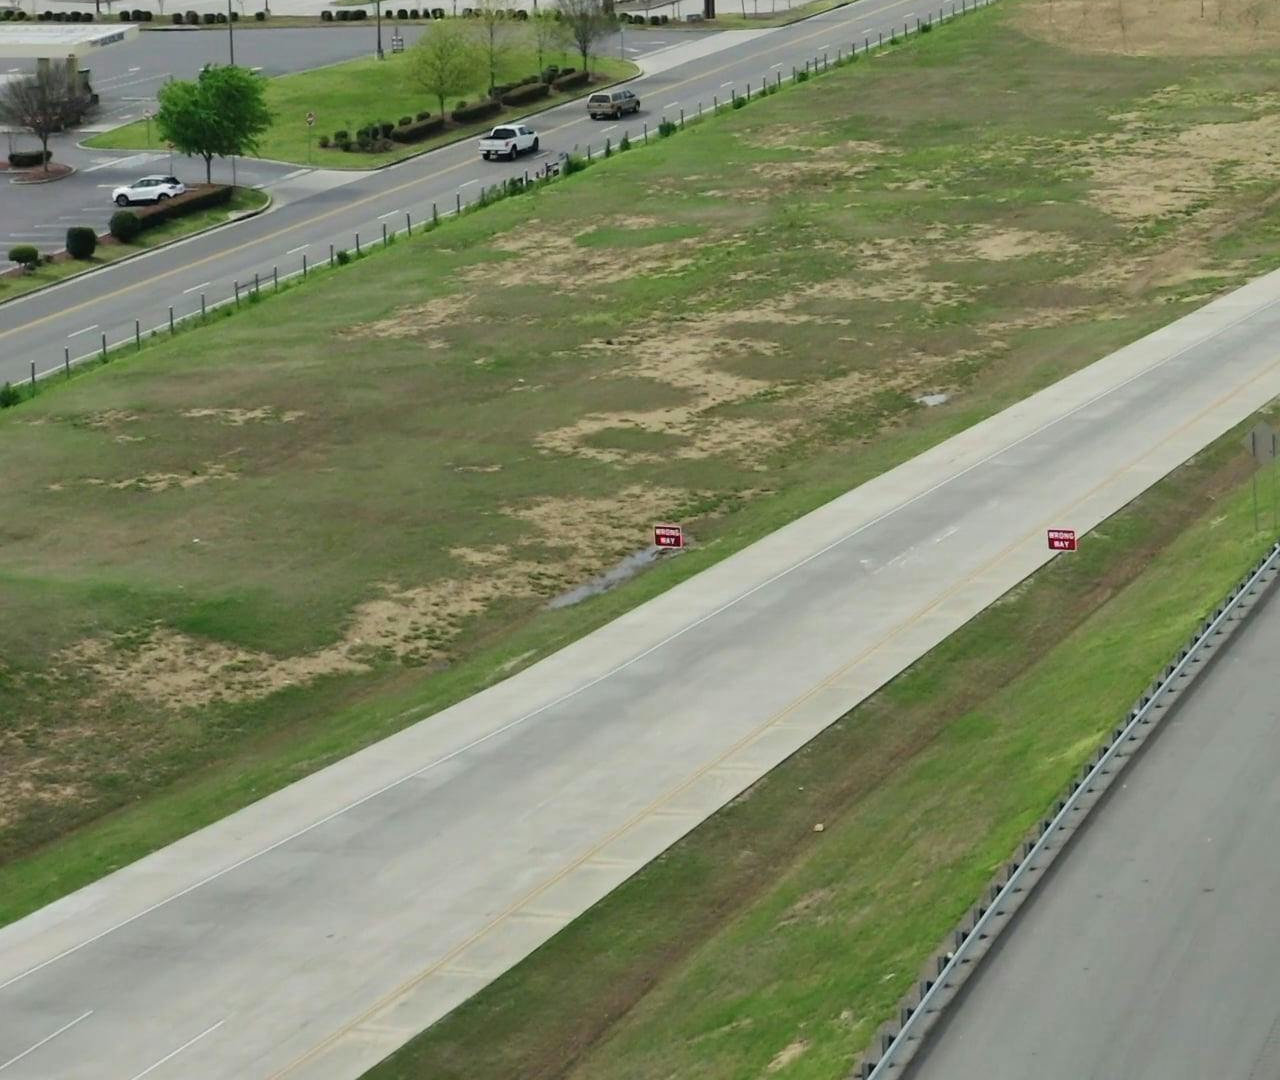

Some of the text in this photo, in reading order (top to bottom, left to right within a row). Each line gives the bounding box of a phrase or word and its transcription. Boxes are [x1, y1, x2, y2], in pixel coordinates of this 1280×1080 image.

[656, 528, 680, 536] WRONG
[1049, 531, 1074, 539] WRONG
[1053, 540, 1070, 548] WAY
